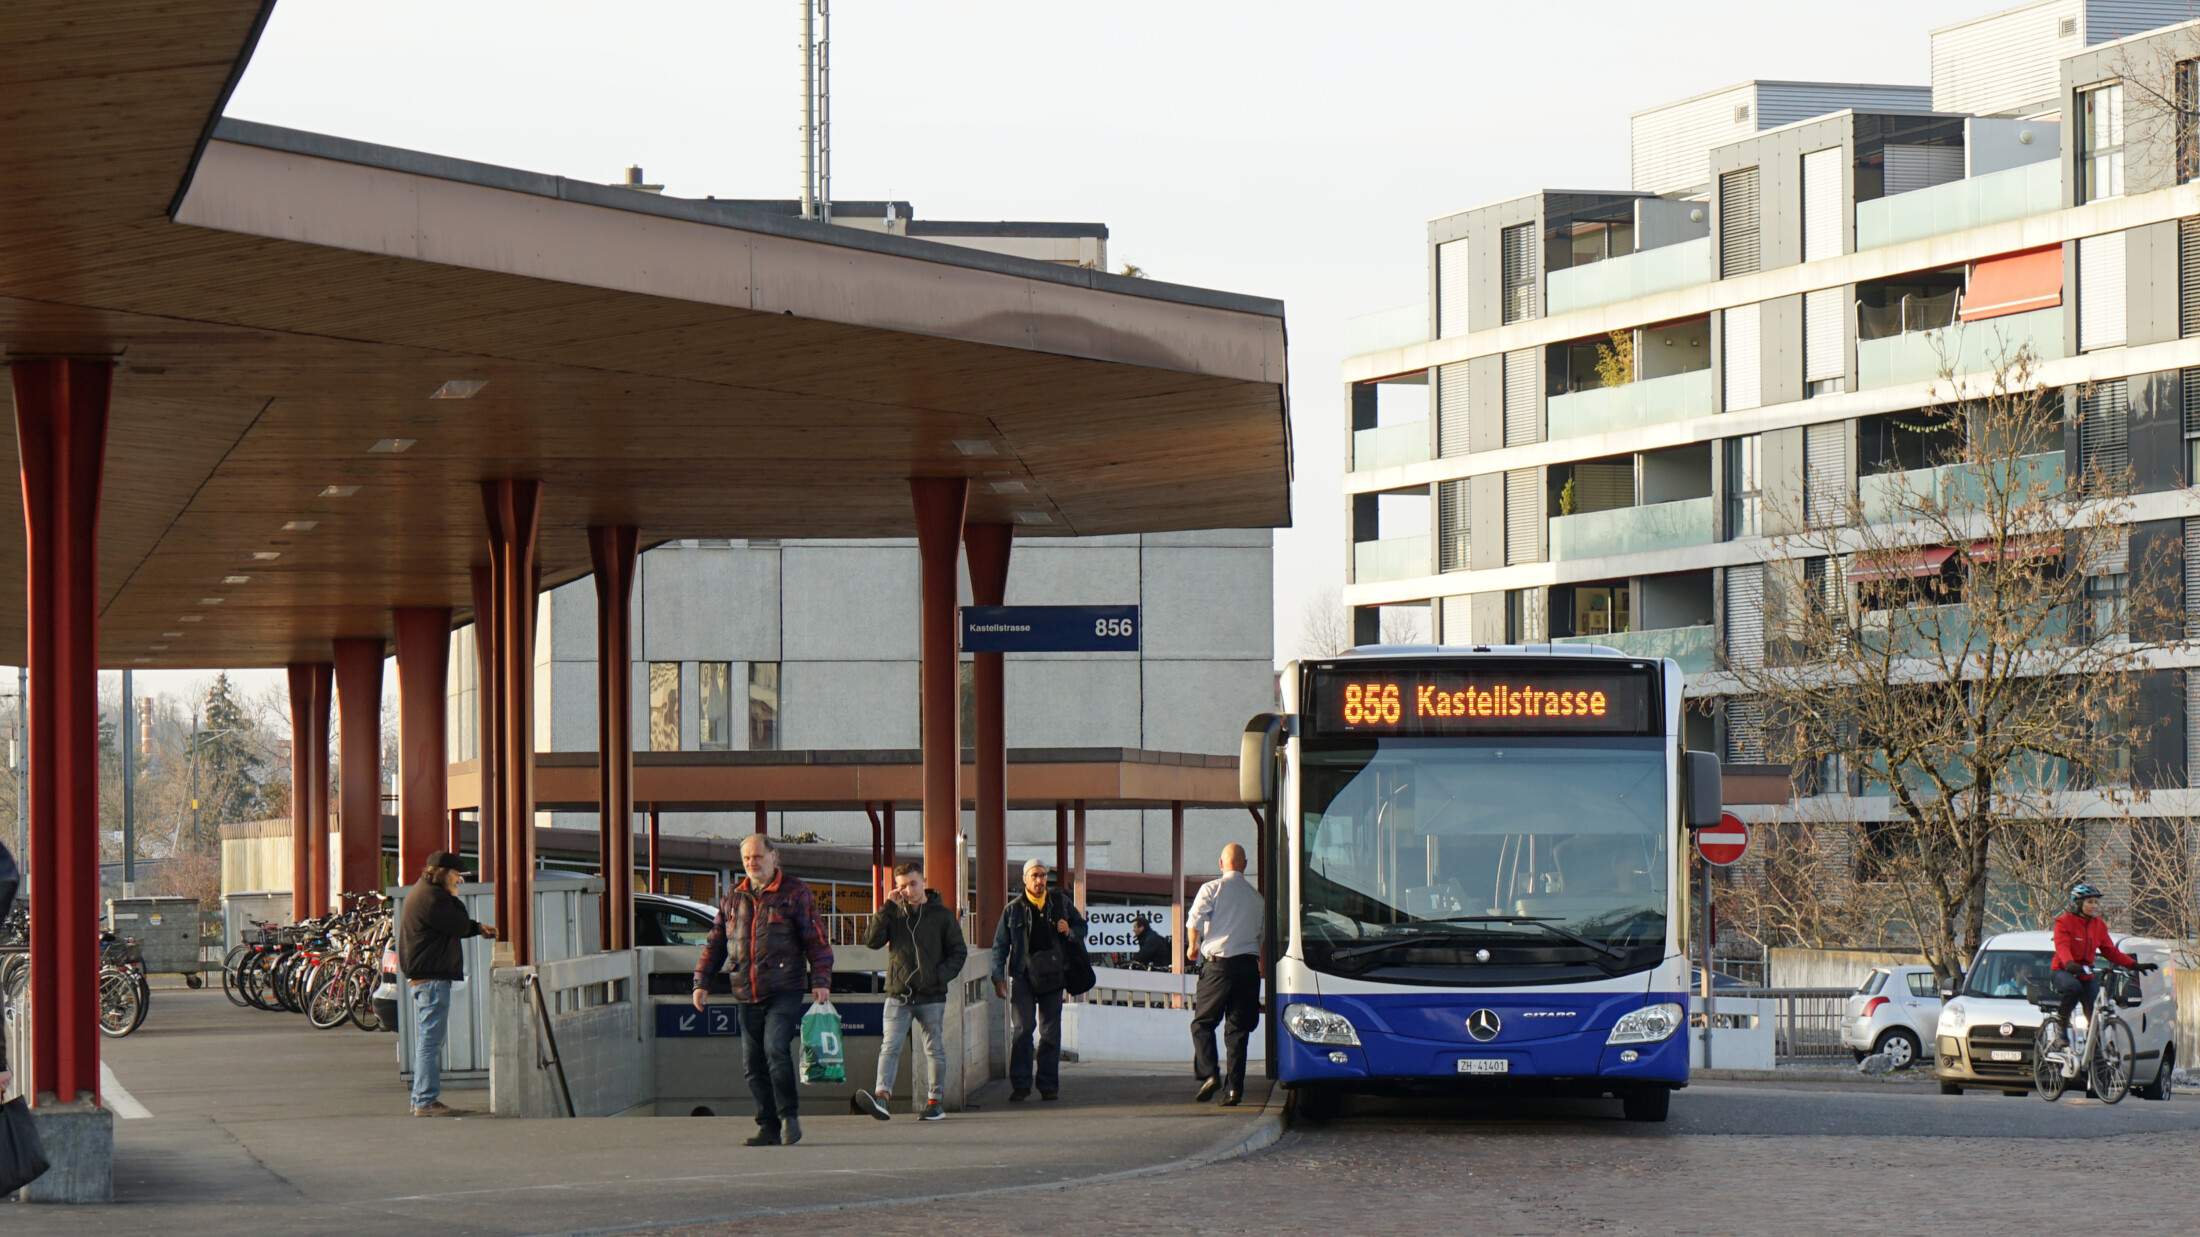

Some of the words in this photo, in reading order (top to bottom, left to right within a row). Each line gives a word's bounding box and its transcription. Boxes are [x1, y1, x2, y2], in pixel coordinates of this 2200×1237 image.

[969, 623, 1031, 632] Kastellstrasse
[1095, 618, 1133, 637] 856
[1344, 684, 1401, 724] 856
[1417, 685, 1607, 717] Kastellstrasse
[716, 1014, 729, 1031] 2
[821, 1031, 839, 1056] D
